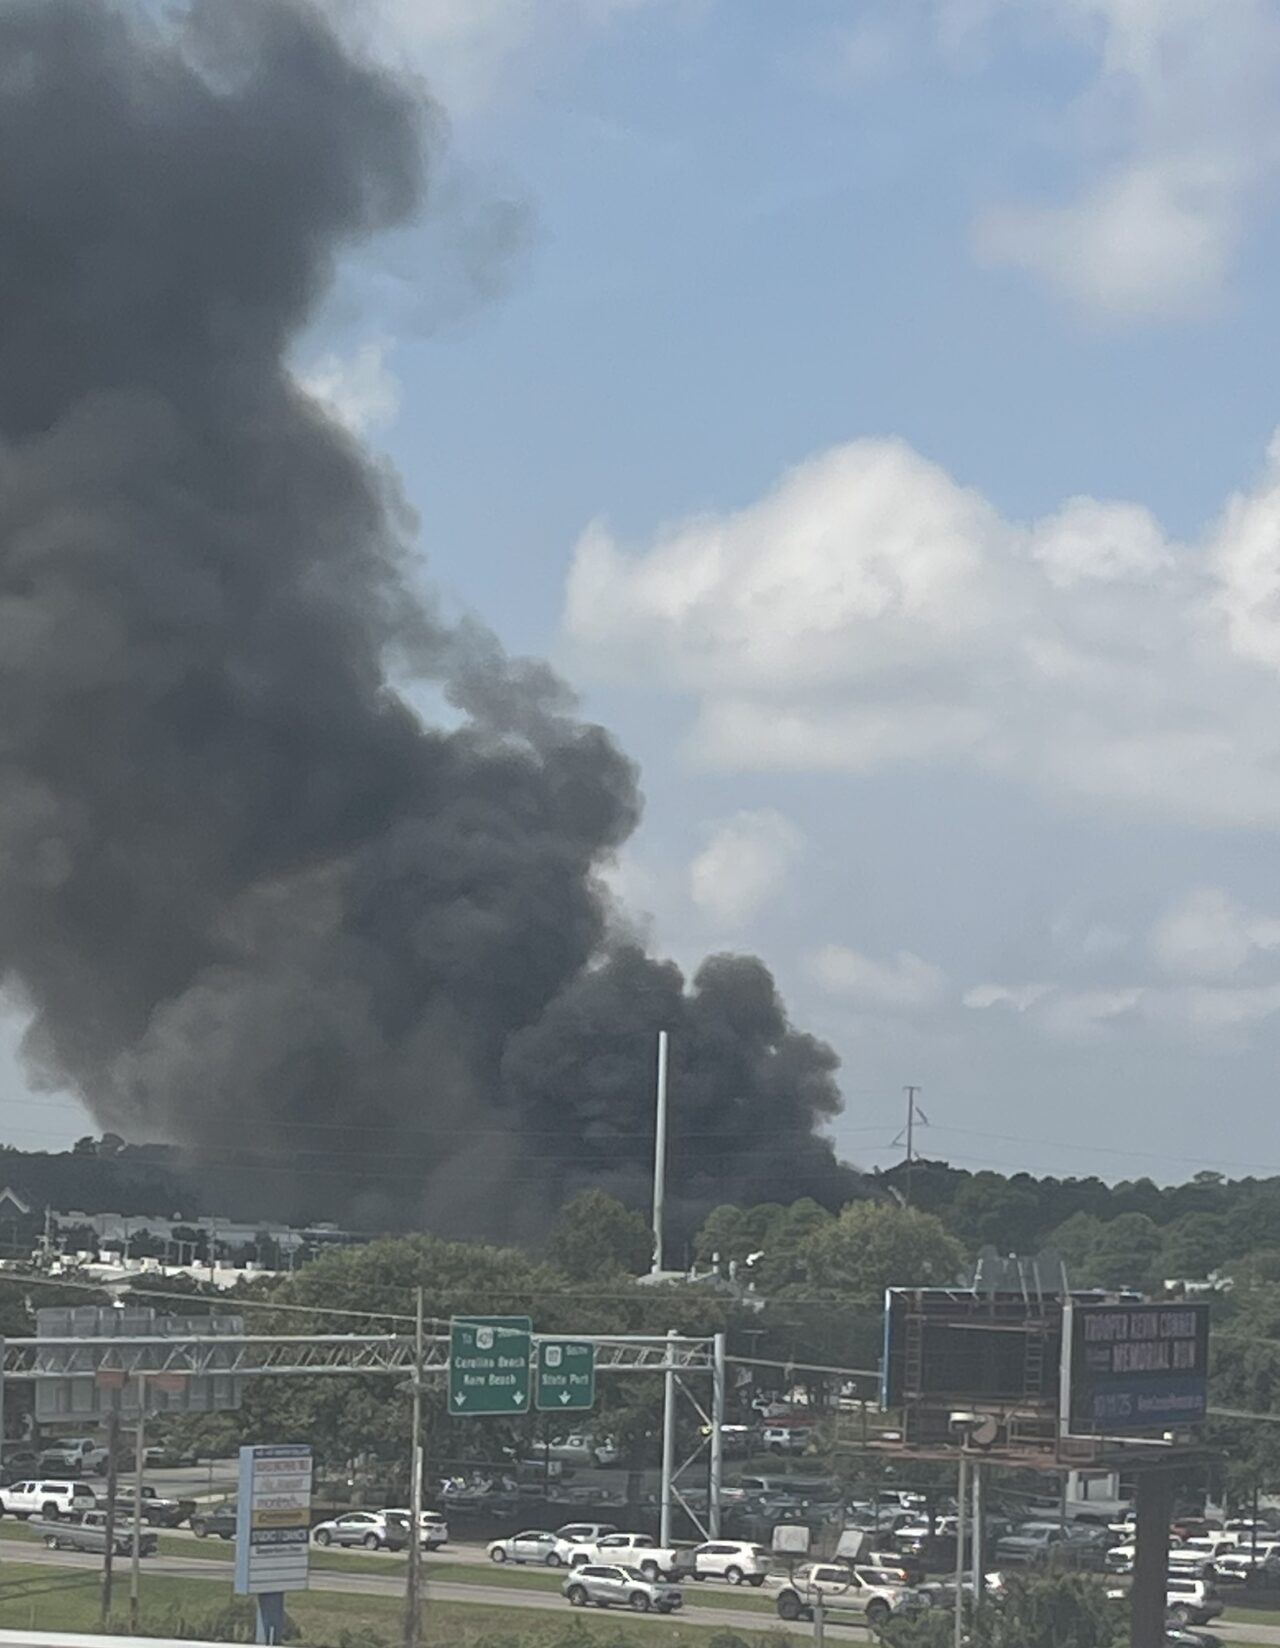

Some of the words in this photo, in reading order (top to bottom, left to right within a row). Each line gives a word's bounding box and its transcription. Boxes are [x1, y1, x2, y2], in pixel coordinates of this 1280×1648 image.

[1084, 1313, 1128, 1340] TROOPER
[455, 1357, 495, 1368] Carolina
[498, 1356, 525, 1368] Beach
[1113, 1342, 1170, 1372] MEMORIAL
[489, 1373, 517, 1385] Beach
[542, 1374, 566, 1385] State
[570, 1373, 589, 1385] Port
